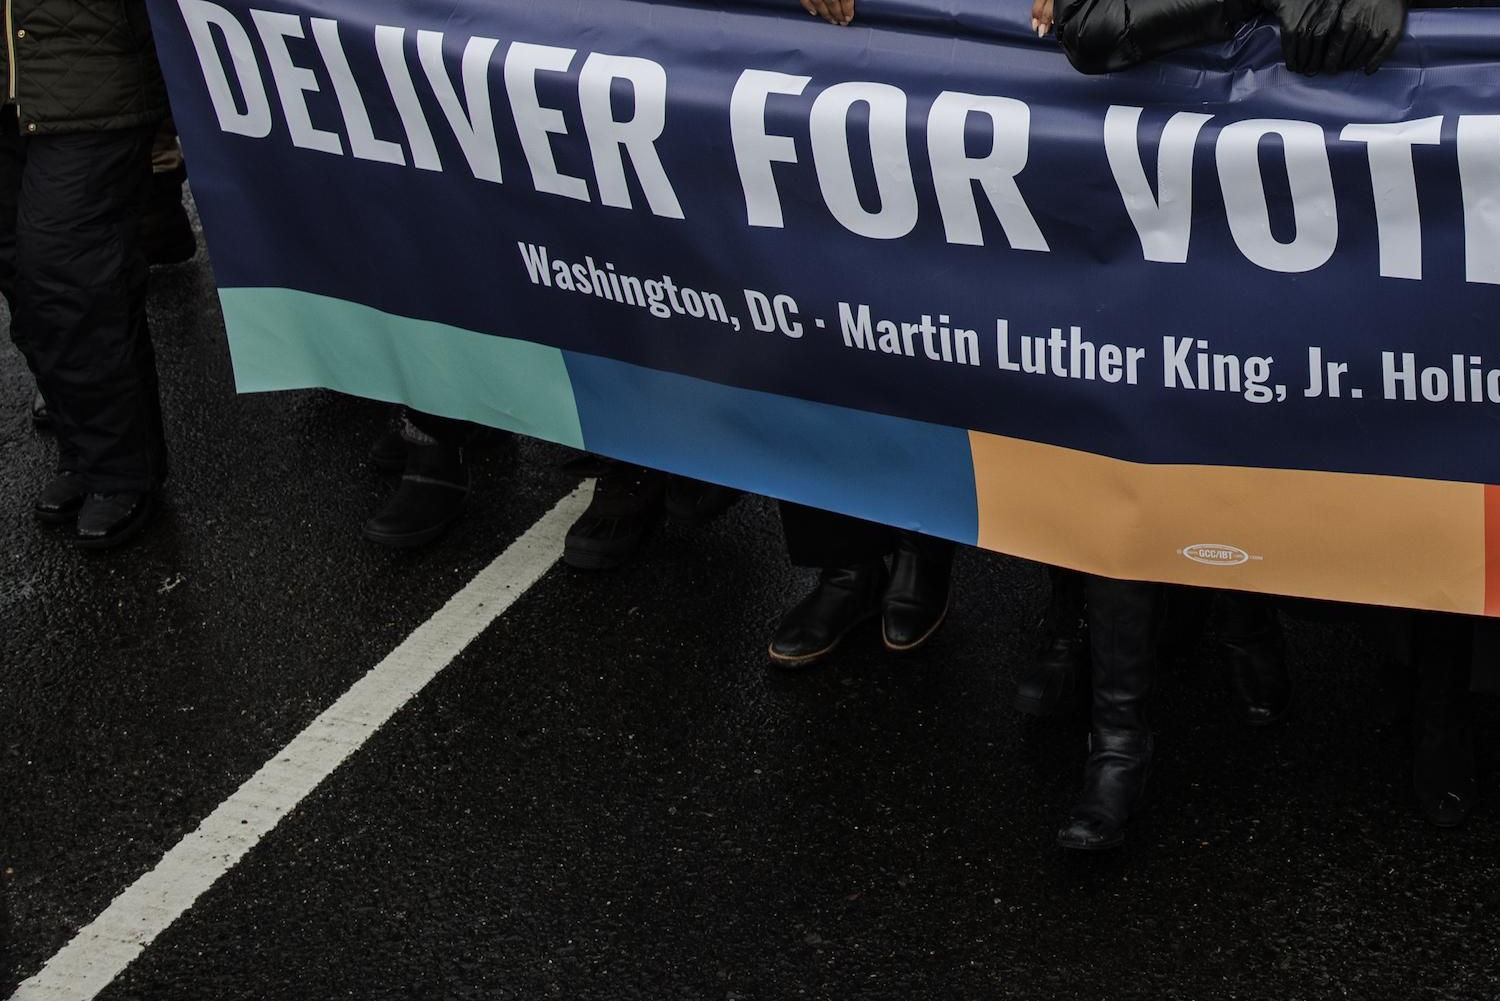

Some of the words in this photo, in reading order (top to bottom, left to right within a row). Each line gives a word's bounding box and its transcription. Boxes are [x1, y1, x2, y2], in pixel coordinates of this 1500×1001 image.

[730, 69, 1051, 252] FOR
[517, 241, 741, 333] Washington,
[750, 286, 806, 341] DC
[838, 301, 981, 367] Martin
[997, 320, 1145, 385] Luther
[1163, 335, 1288, 403] King,
[1304, 347, 1363, 400] Jr.
[1199, 549, 1233, 560] GCC/IBT
